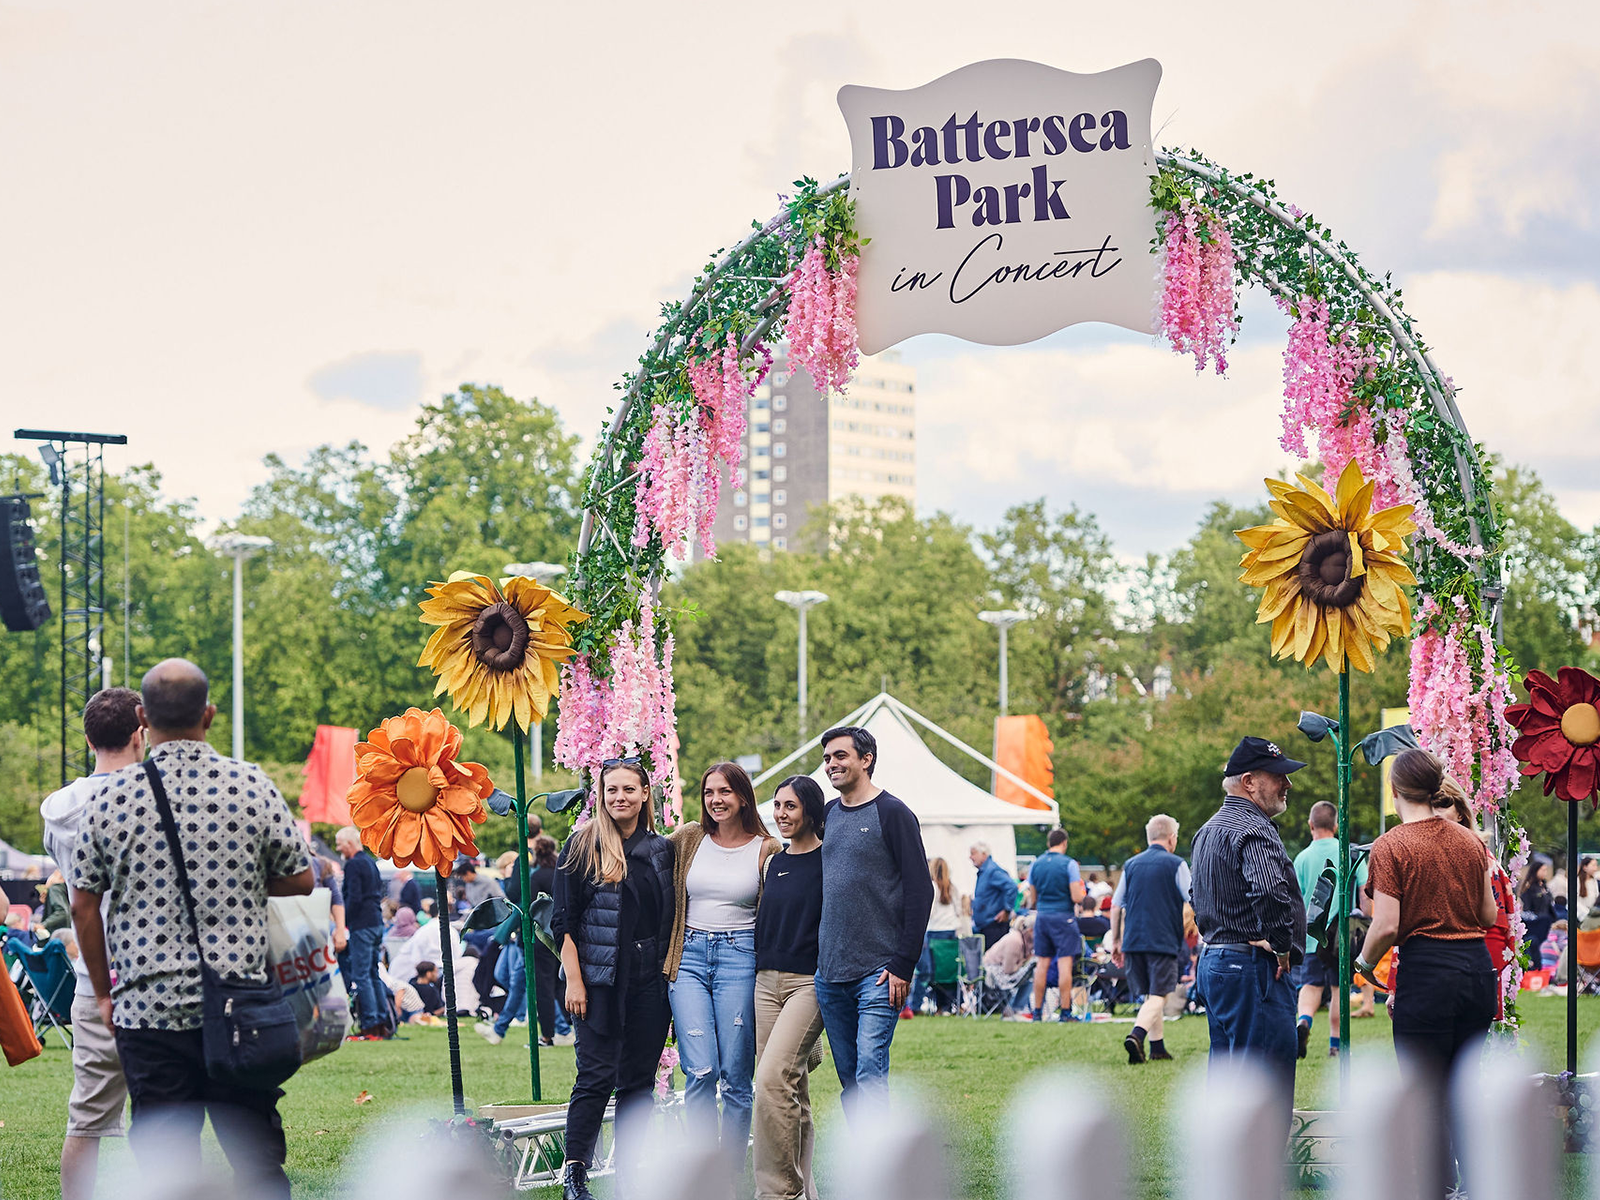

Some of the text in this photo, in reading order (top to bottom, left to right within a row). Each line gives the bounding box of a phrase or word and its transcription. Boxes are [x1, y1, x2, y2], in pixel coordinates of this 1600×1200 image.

[869, 110, 1132, 171] Battersea
[933, 164, 1072, 230] Park
[890, 233, 1123, 304] in Concert
